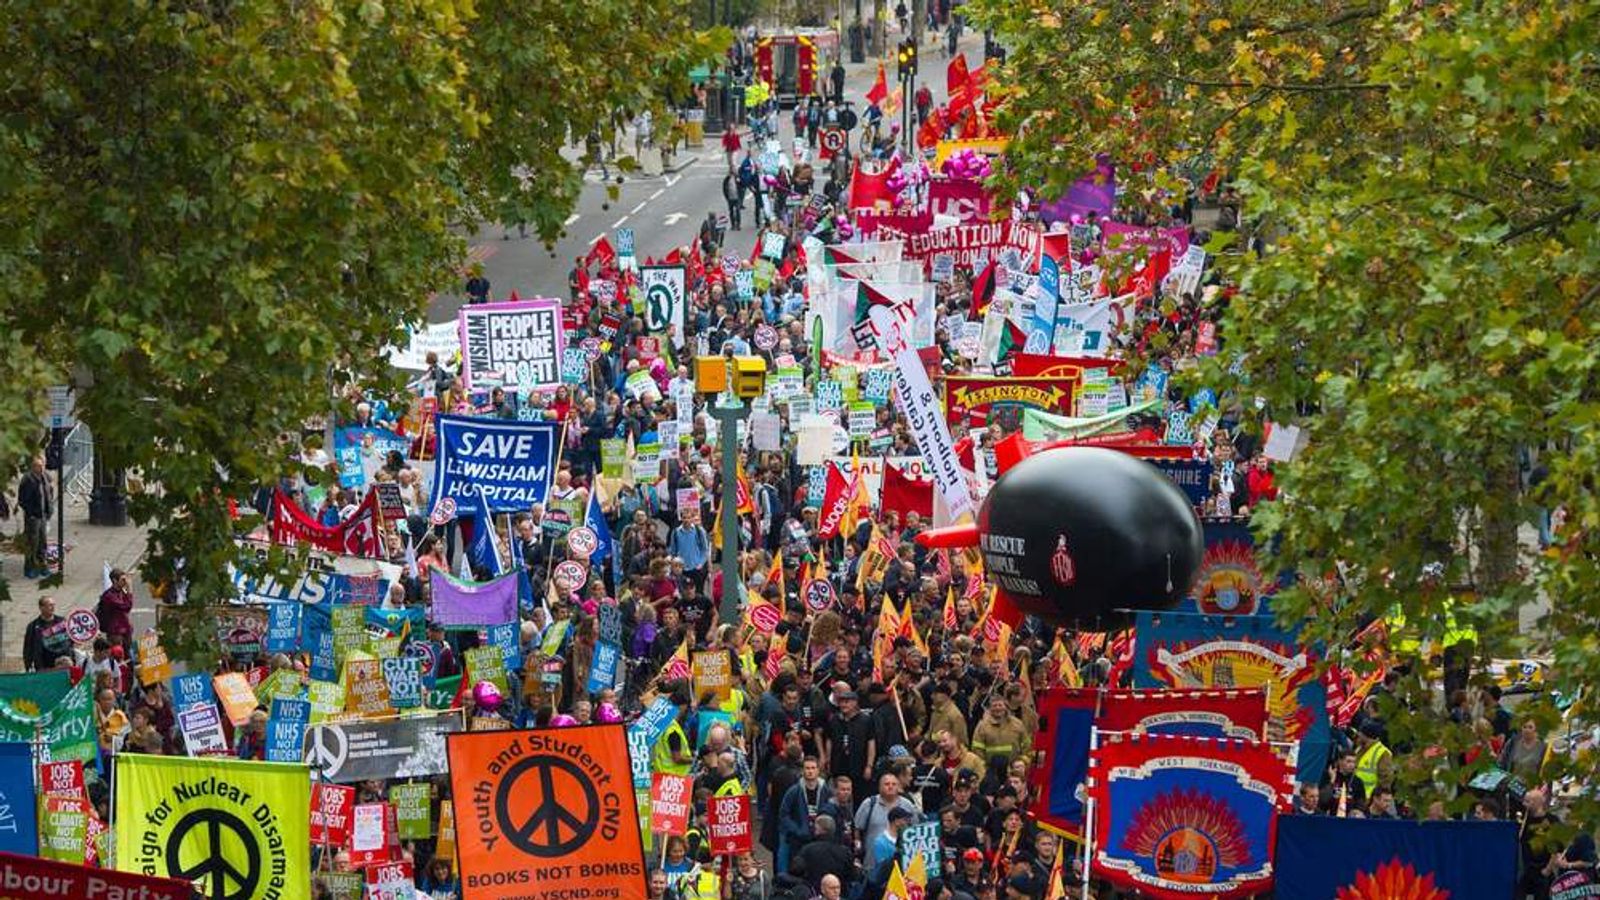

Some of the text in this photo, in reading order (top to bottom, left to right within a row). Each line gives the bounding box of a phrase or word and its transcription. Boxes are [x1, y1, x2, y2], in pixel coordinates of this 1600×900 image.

[911, 223, 1001, 252] EDUCATION
[1007, 222, 1038, 251] NOW
[490, 312, 551, 338] PEOPLE
[492, 336, 553, 361] BEFORE
[494, 359, 554, 386] PROFIT
[818, 381, 842, 390] CUT
[968, 385, 1049, 402] ISLINGTON
[518, 408, 543, 419] CUT
[457, 432, 533, 460] SAVE
[447, 458, 546, 483] LEWISHAM
[810, 467, 826, 477] CU
[449, 481, 537, 501] HOSPITAL
[989, 534, 1025, 556] RESCUE
[73, 615, 89, 625] NO
[276, 605, 293, 618] NHS
[494, 626, 513, 641] NHS
[383, 659, 419, 671] CUT
[695, 653, 727, 666] HOMES
[180, 676, 203, 694] NHS
[384, 670, 420, 683] WAR
[280, 702, 303, 718] NHS
[275, 722, 298, 739] NHS
[628, 731, 648, 745] UT
[276, 739, 295, 750] NOT
[269, 749, 301, 762] TRIDENT
[1158, 758, 1184, 768] WEST
[50, 763, 75, 781] JOBS
[53, 780, 73, 790] NOT
[659, 774, 685, 793] JOBS
[145, 798, 173, 826] for
[172, 776, 252, 806] Nuclear
[321, 787, 347, 805] JOBS
[473, 735, 621, 852] Youth and Student CND
[661, 789, 682, 804] NOT
[652, 800, 687, 817] TRIDENT
[715, 798, 741, 815] JOBS
[50, 813, 85, 826] CLIMATE
[718, 813, 739, 824] NOT
[56, 826, 75, 836] NOT
[712, 822, 748, 838] TRIDENT
[902, 822, 940, 842] CUT
[903, 836, 940, 854] WAR
[0, 865, 171, 900] bour Party
[377, 865, 405, 883] JOBS
[468, 862, 641, 888] BOOKS NOT BOMBS
